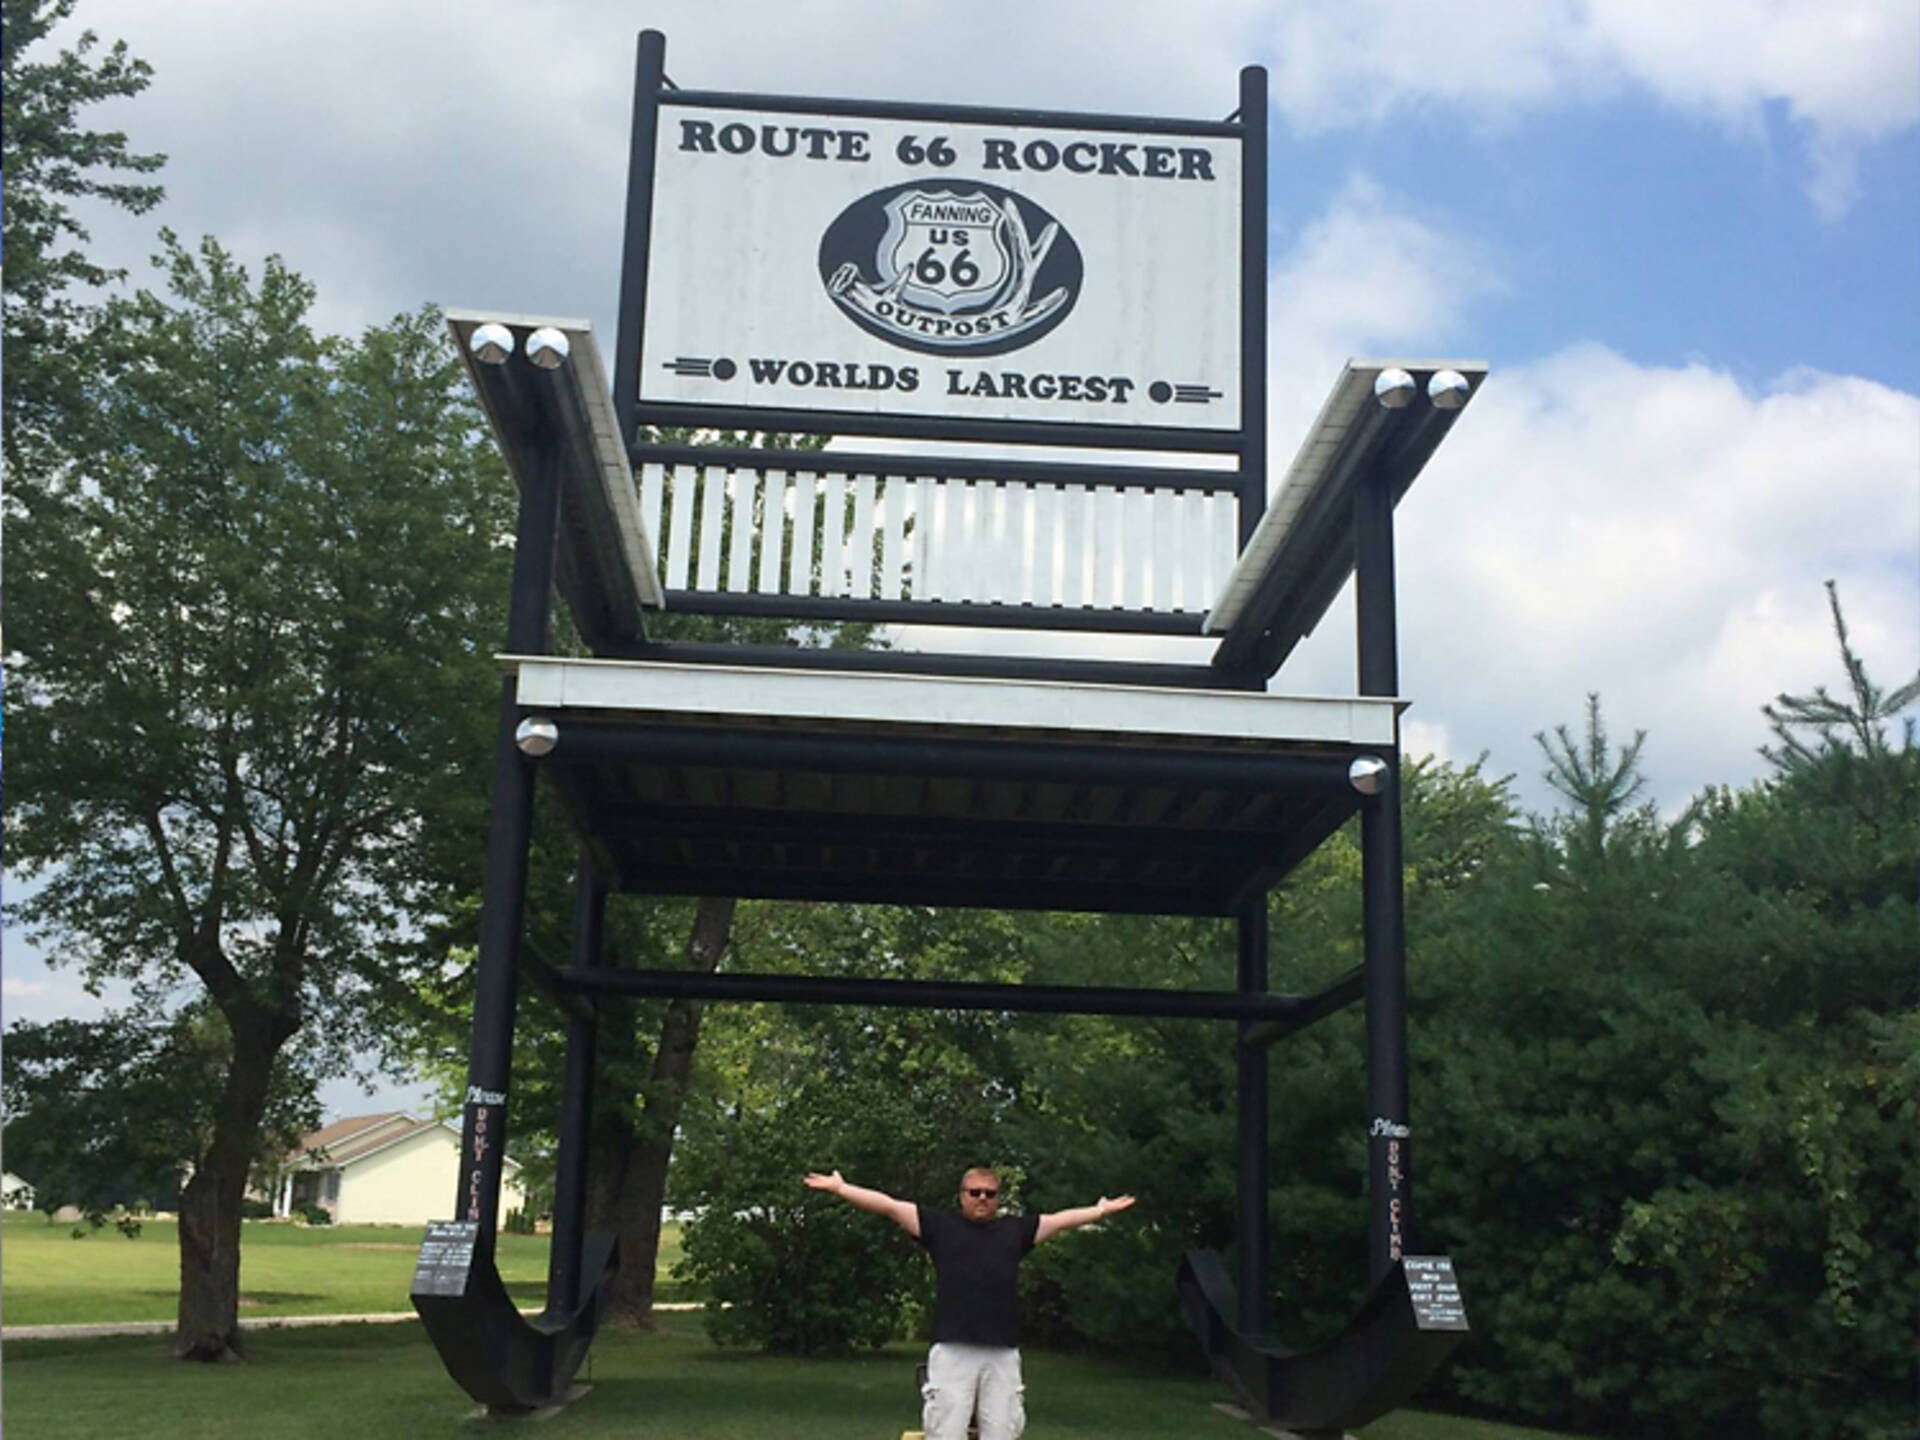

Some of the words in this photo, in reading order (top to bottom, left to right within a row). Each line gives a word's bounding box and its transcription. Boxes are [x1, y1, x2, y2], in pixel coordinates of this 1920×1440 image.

[679, 119, 870, 162] ROUTE
[897, 135, 957, 168] 66
[982, 138, 1216, 182] ROCKER
[911, 204, 992, 224] FANNING
[929, 228, 970, 247] US
[916, 247, 980, 288] 66
[875, 301, 1010, 337] OUTPOST
[749, 359, 920, 392] WORLDS
[947, 370, 1135, 404] LARGEST
